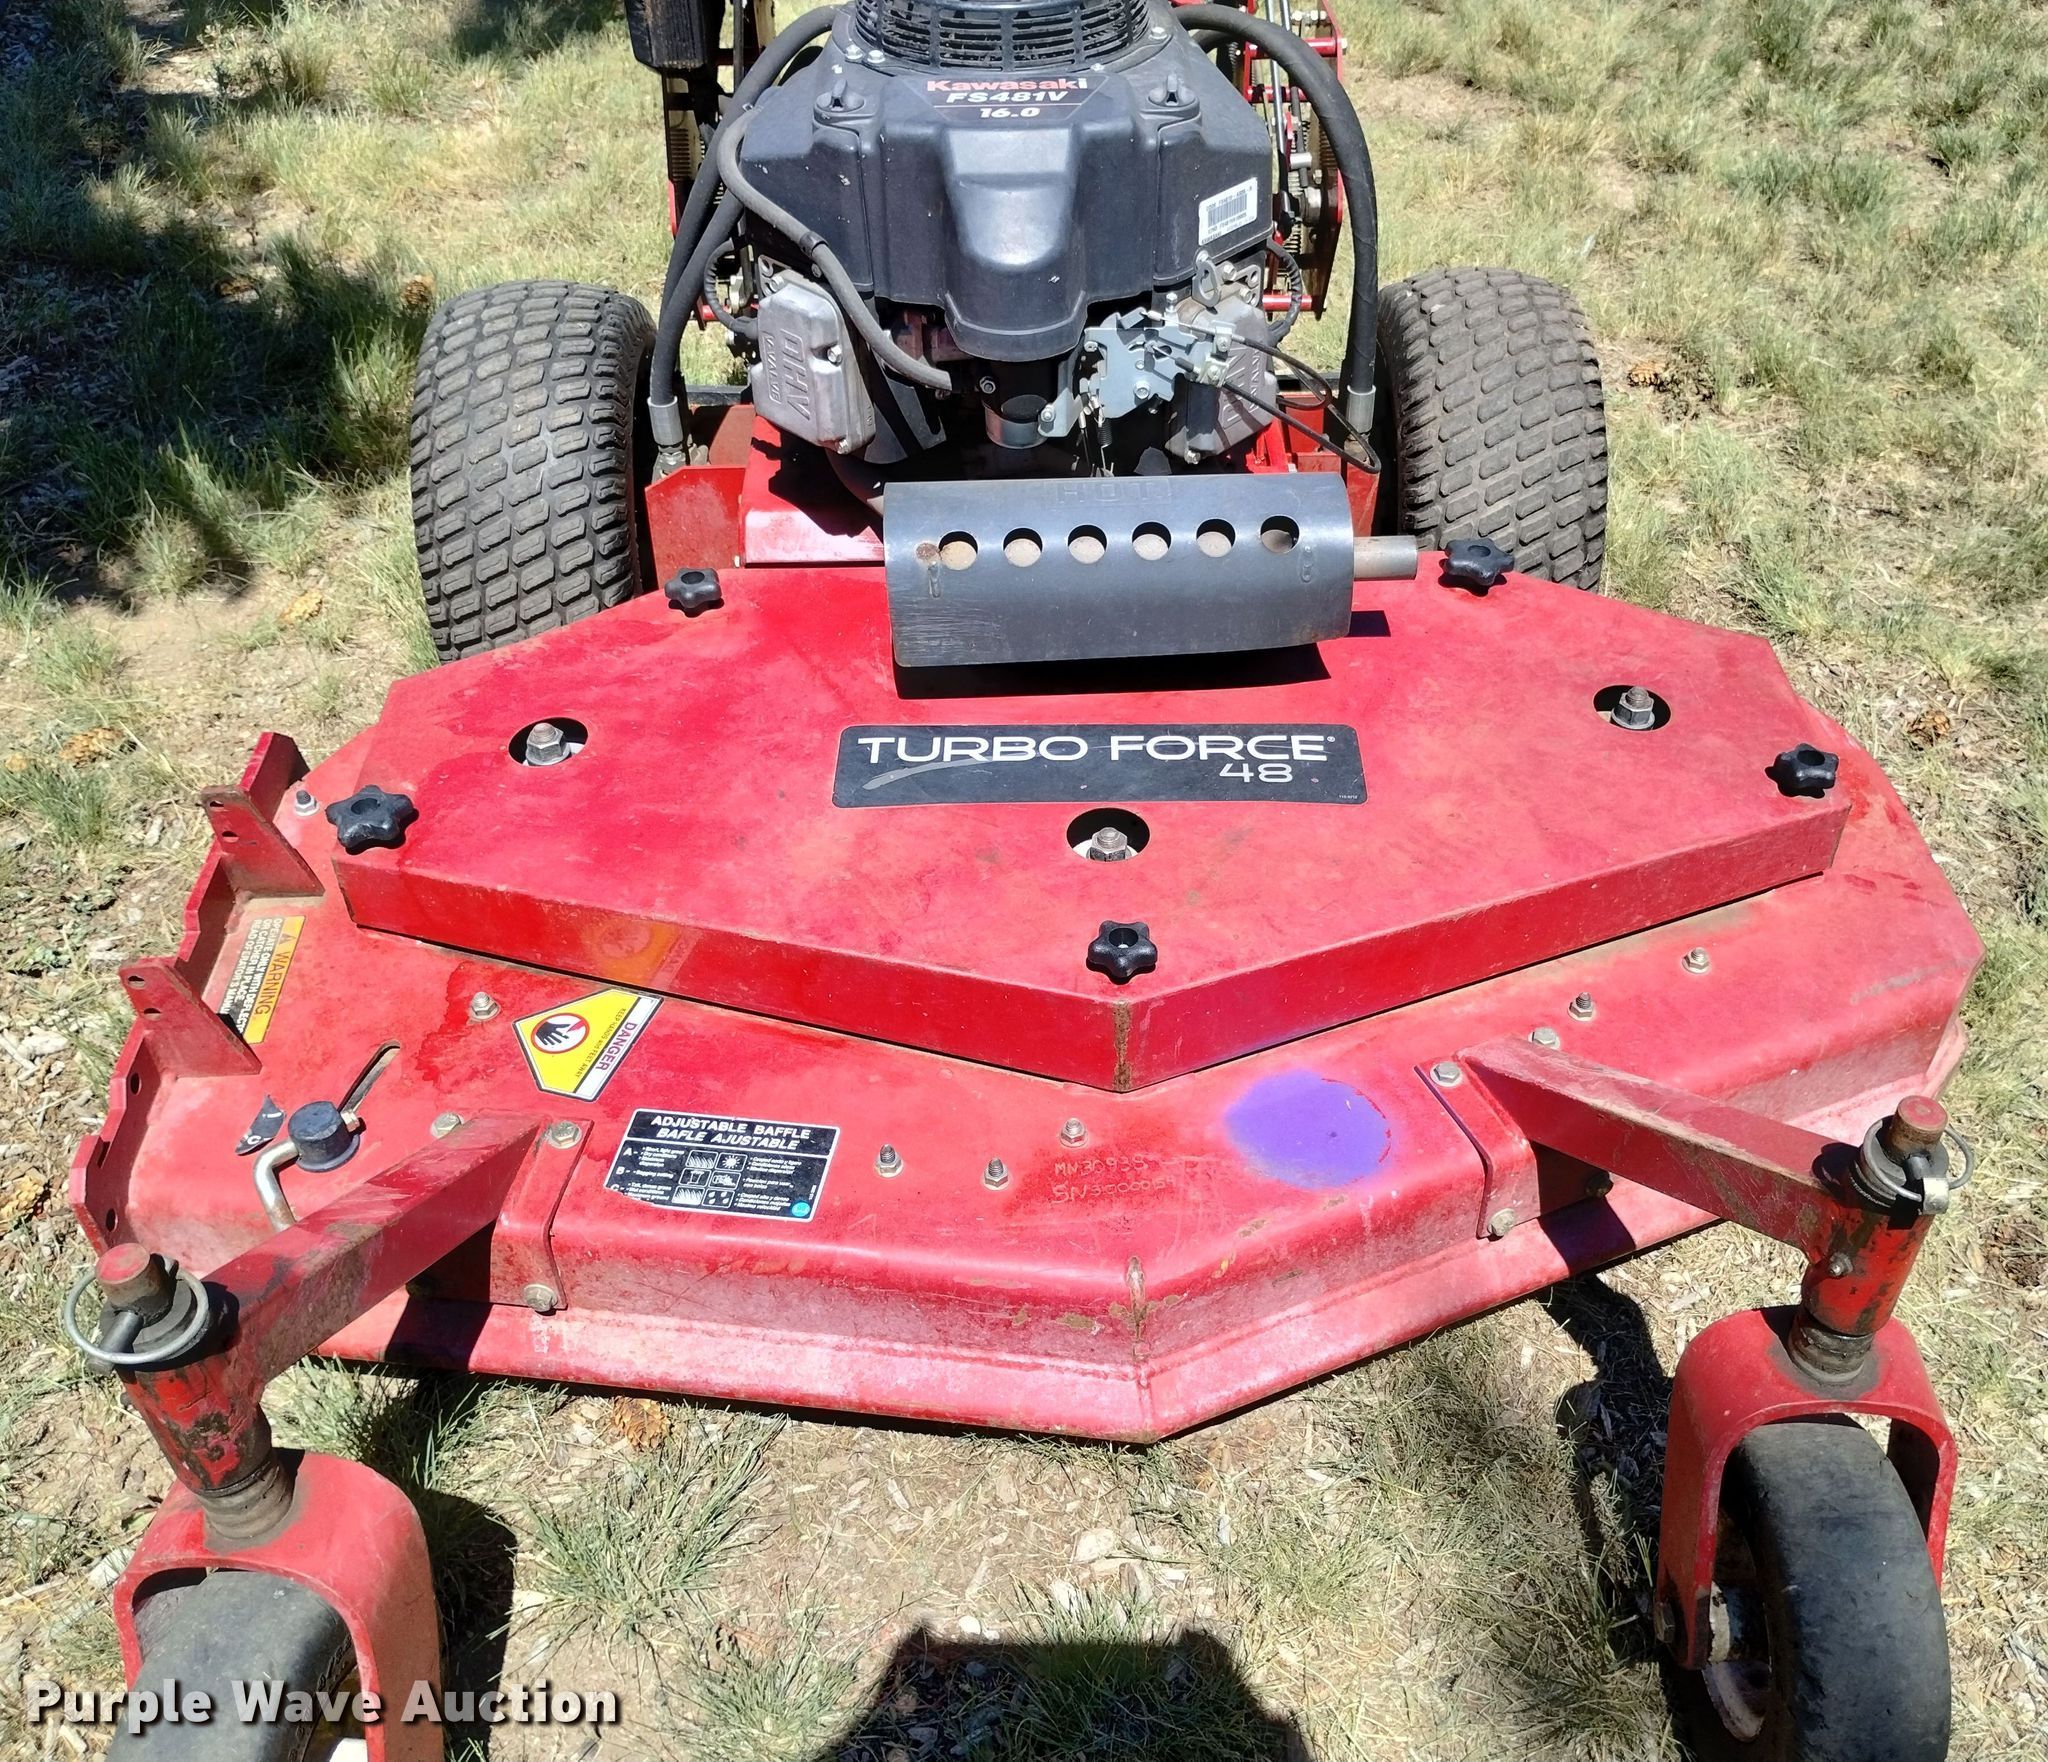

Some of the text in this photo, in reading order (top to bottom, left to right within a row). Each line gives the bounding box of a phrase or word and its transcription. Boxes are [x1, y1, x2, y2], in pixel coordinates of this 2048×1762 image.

[927, 78, 1087, 92] Kawasaki
[946, 90, 1069, 103] FS481V
[979, 107, 1041, 118] 16.0
[857, 735, 1328, 764] TURBO FORCE
[1219, 763, 1293, 783] 48
[249, 930, 268, 965] CATCHER
[245, 965, 256, 975] IN
[256, 953, 271, 973] ONLY
[249, 973, 264, 994] WITH
[255, 951, 291, 1015] WARNING
[595, 1021, 638, 1070] DANGER
[651, 1115, 811, 1139] ADJUSTABLE BAFFLE
[656, 1128, 800, 1150] BAFLE AJUSTABLE
